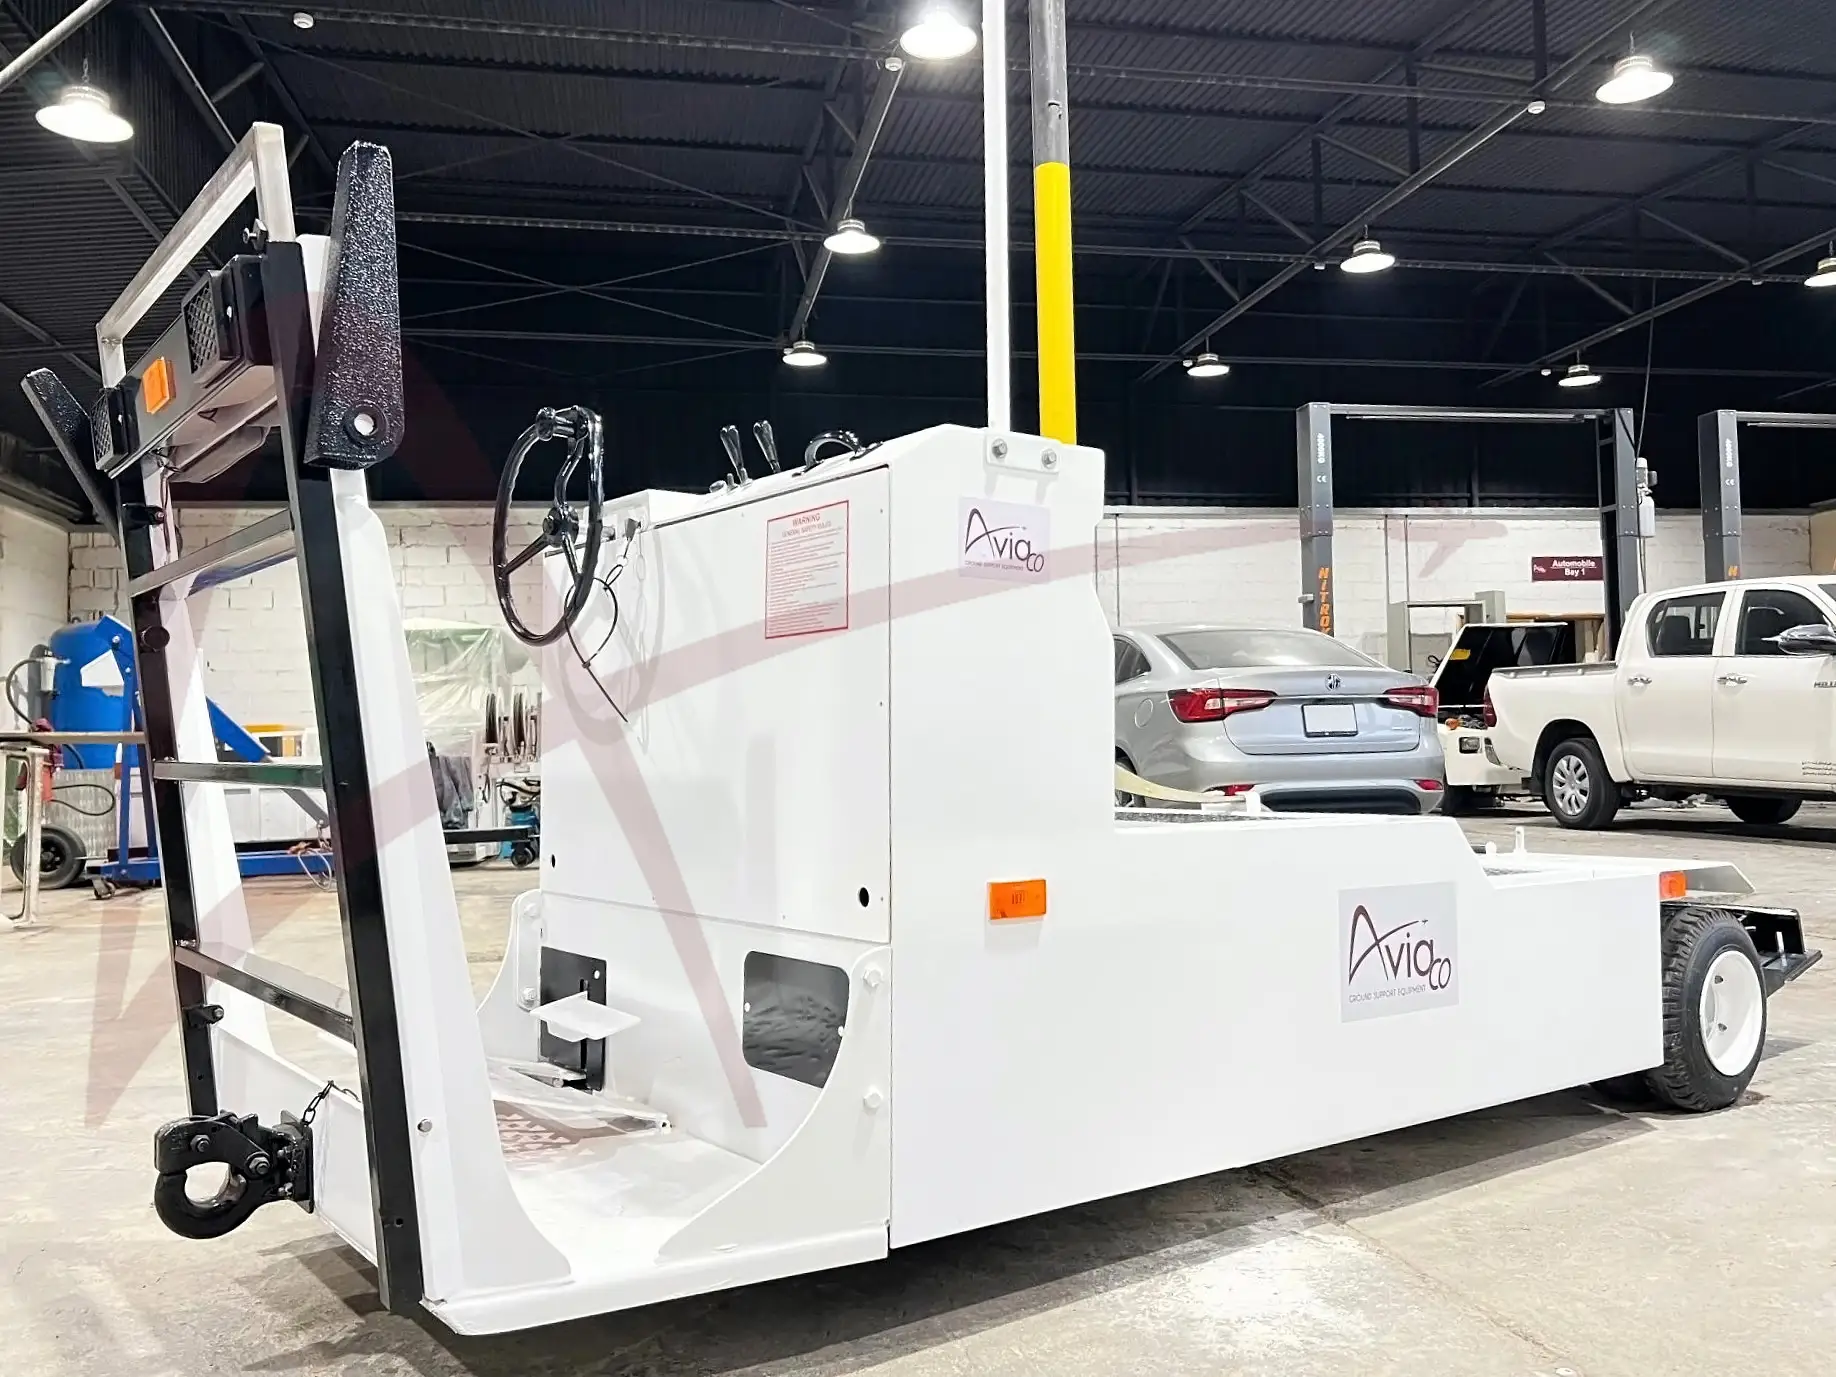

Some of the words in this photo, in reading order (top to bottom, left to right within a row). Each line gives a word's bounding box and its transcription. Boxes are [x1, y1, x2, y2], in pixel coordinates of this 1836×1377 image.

[792, 512, 821, 527] WARNING
[1552, 559, 1595, 567] Automobile
[1564, 568, 1580, 577] Bay
[1348, 992, 1372, 1003] GROUND
[1373, 988, 1397, 1000] SUPPORT
[1397, 984, 1427, 996] EQUIPMENT
